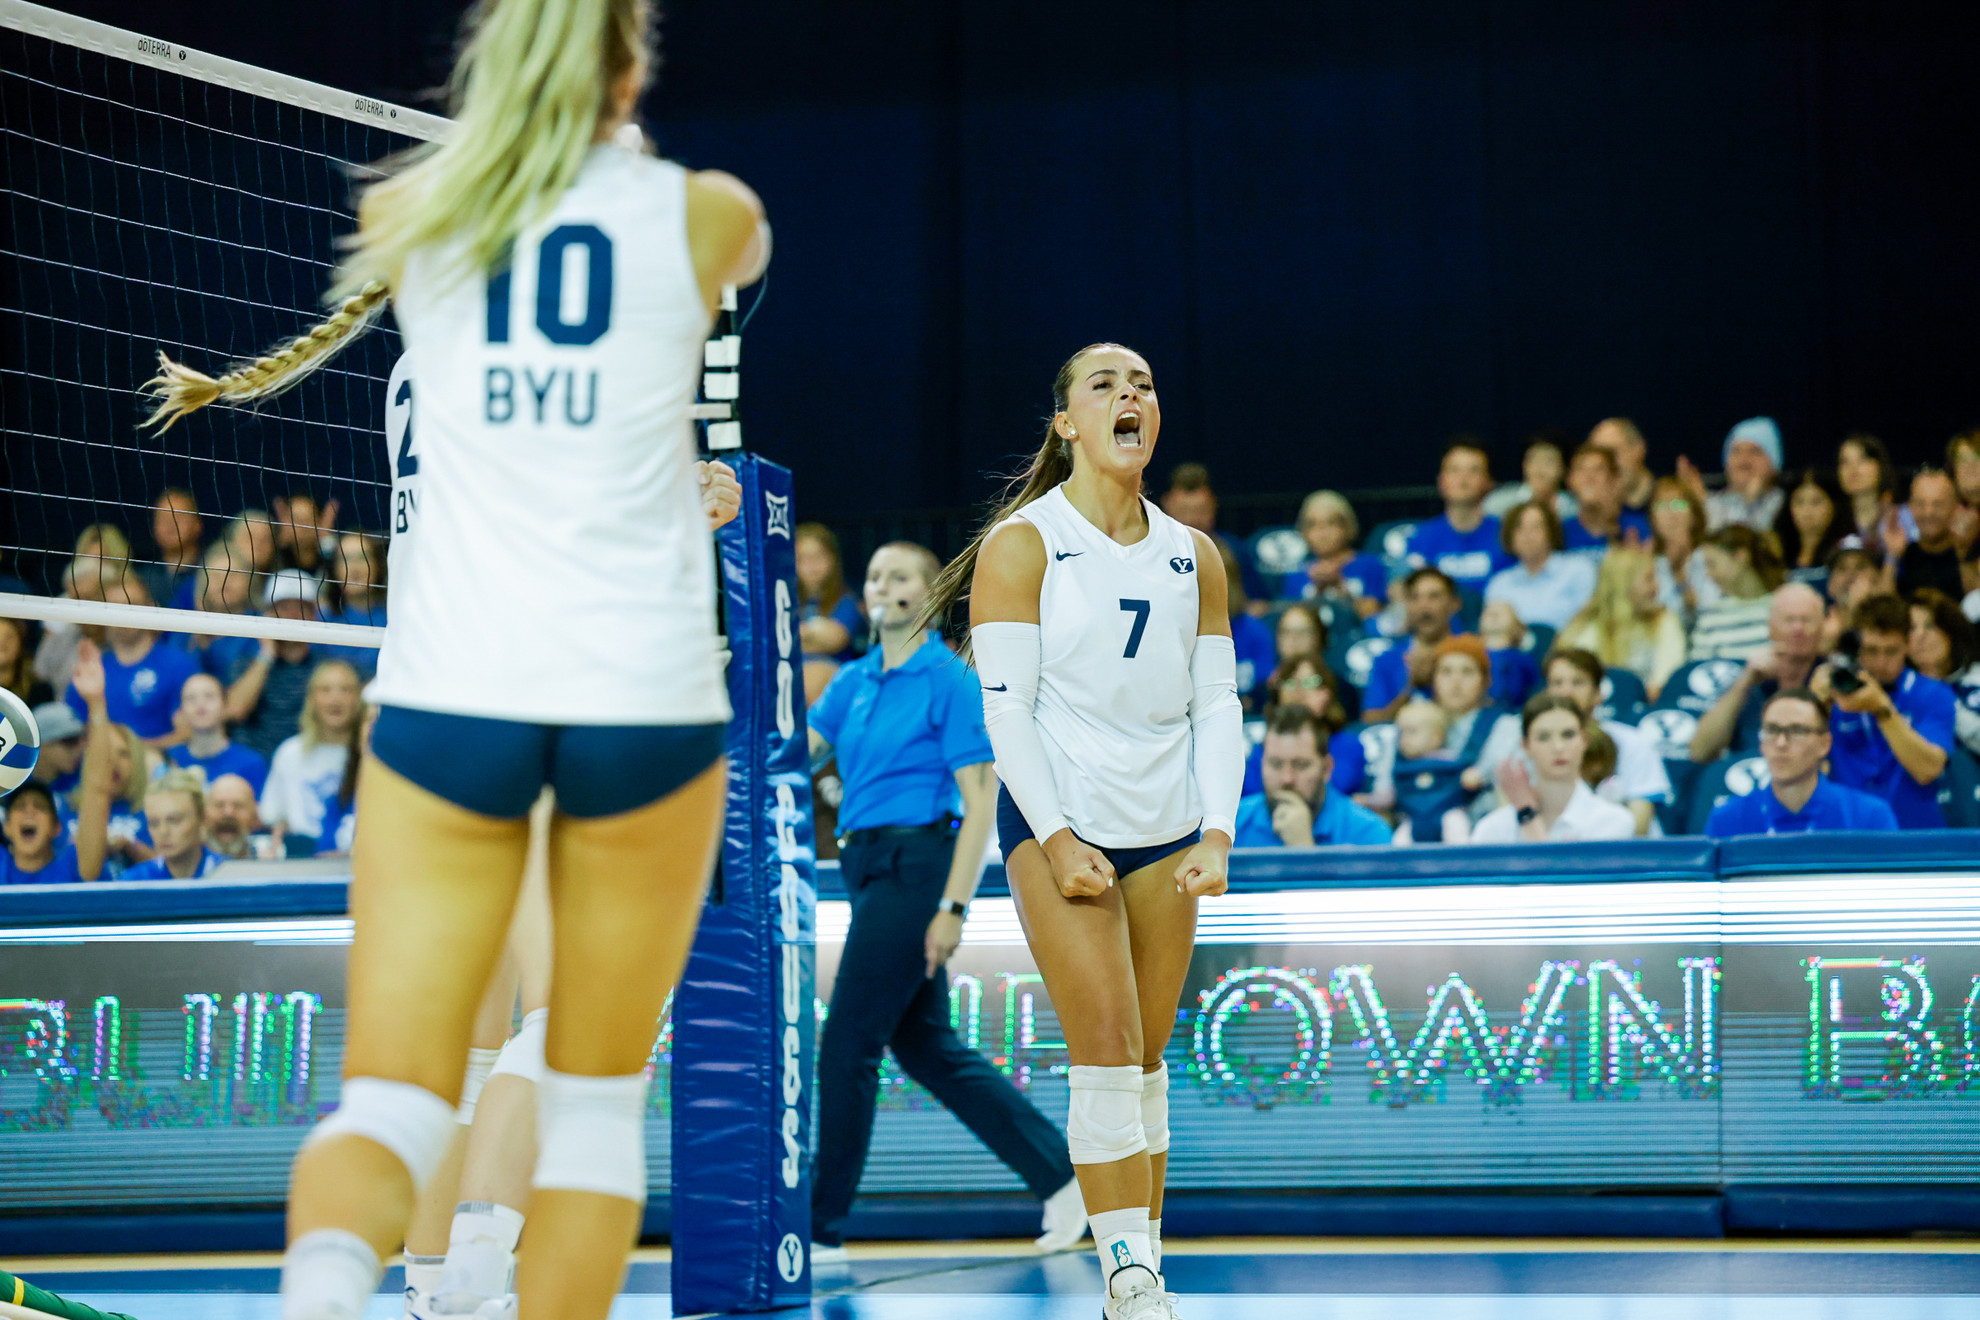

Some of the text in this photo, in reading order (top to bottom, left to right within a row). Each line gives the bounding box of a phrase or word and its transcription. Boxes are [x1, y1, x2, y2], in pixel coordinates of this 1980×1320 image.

[485, 225, 613, 346] 10
[486, 368, 598, 426] BYU
[1119, 598, 1151, 658] 7
[775, 578, 801, 1188] GO COUGS
